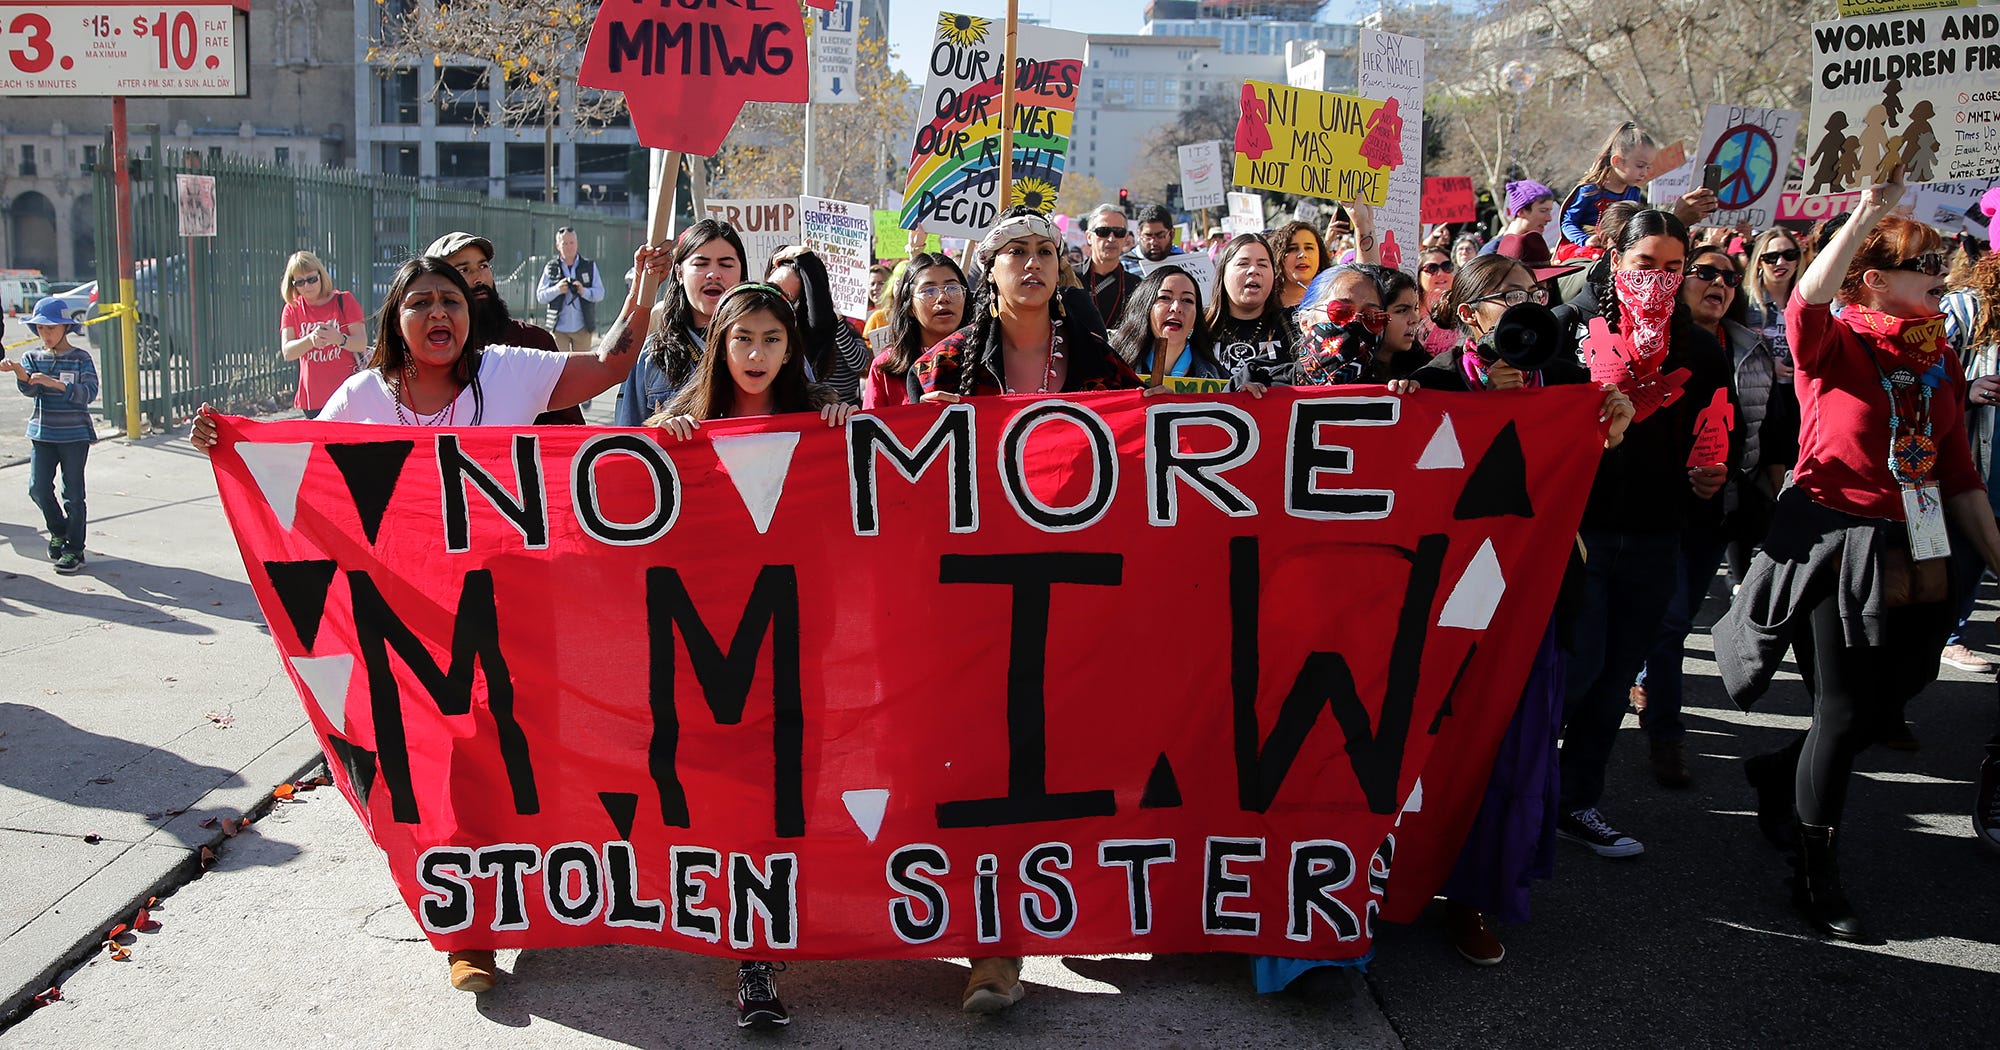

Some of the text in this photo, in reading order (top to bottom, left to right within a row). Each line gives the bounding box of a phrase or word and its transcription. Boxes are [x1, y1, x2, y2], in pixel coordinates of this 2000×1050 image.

[205, 21, 227, 31] FLAT
[1814, 14, 2000, 54] WOMEN AND
[0, 13, 74, 73] 3.
[133, 11, 220, 70] $10.
[205, 37, 229, 47] RATE
[609, 19, 794, 76] MMIWG
[820, 36, 852, 46] ELECTRIC
[822, 46, 849, 55] VEHICLE
[1376, 33, 1402, 57] SAY
[818, 56, 853, 65] CHARGING
[821, 65, 848, 74] STATION
[931, 41, 990, 83] OUR
[1363, 52, 1420, 79] HER NAME!
[1822, 49, 1956, 90] CHILDREN
[26, 80, 35, 88] 15
[38, 80, 77, 88] MINUTES
[117, 79, 141, 88] AFTER
[142, 79, 147, 88] 4
[178, 79, 183, 88] &
[203, 79, 216, 88] ALL
[217, 79, 230, 88] DAY
[936, 87, 992, 126] OUR
[1268, 88, 1364, 138] NI UNA
[1727, 106, 1789, 139] PEACE
[916, 125, 970, 161] OUR
[1291, 130, 1333, 165] MAS
[960, 167, 996, 198] TO
[1250, 161, 1289, 188] NOT
[1302, 164, 1332, 194] ONE
[1338, 168, 1382, 203] MORE
[1188, 192, 1221, 208] TIME
[706, 203, 795, 232] TRUMP
[805, 222, 828, 233] TOXIC
[807, 230, 829, 241] RAPE
[825, 263, 850, 275] EXISM
[434, 397, 1401, 553] NO MORE
[417, 841, 797, 950] STOLEN
